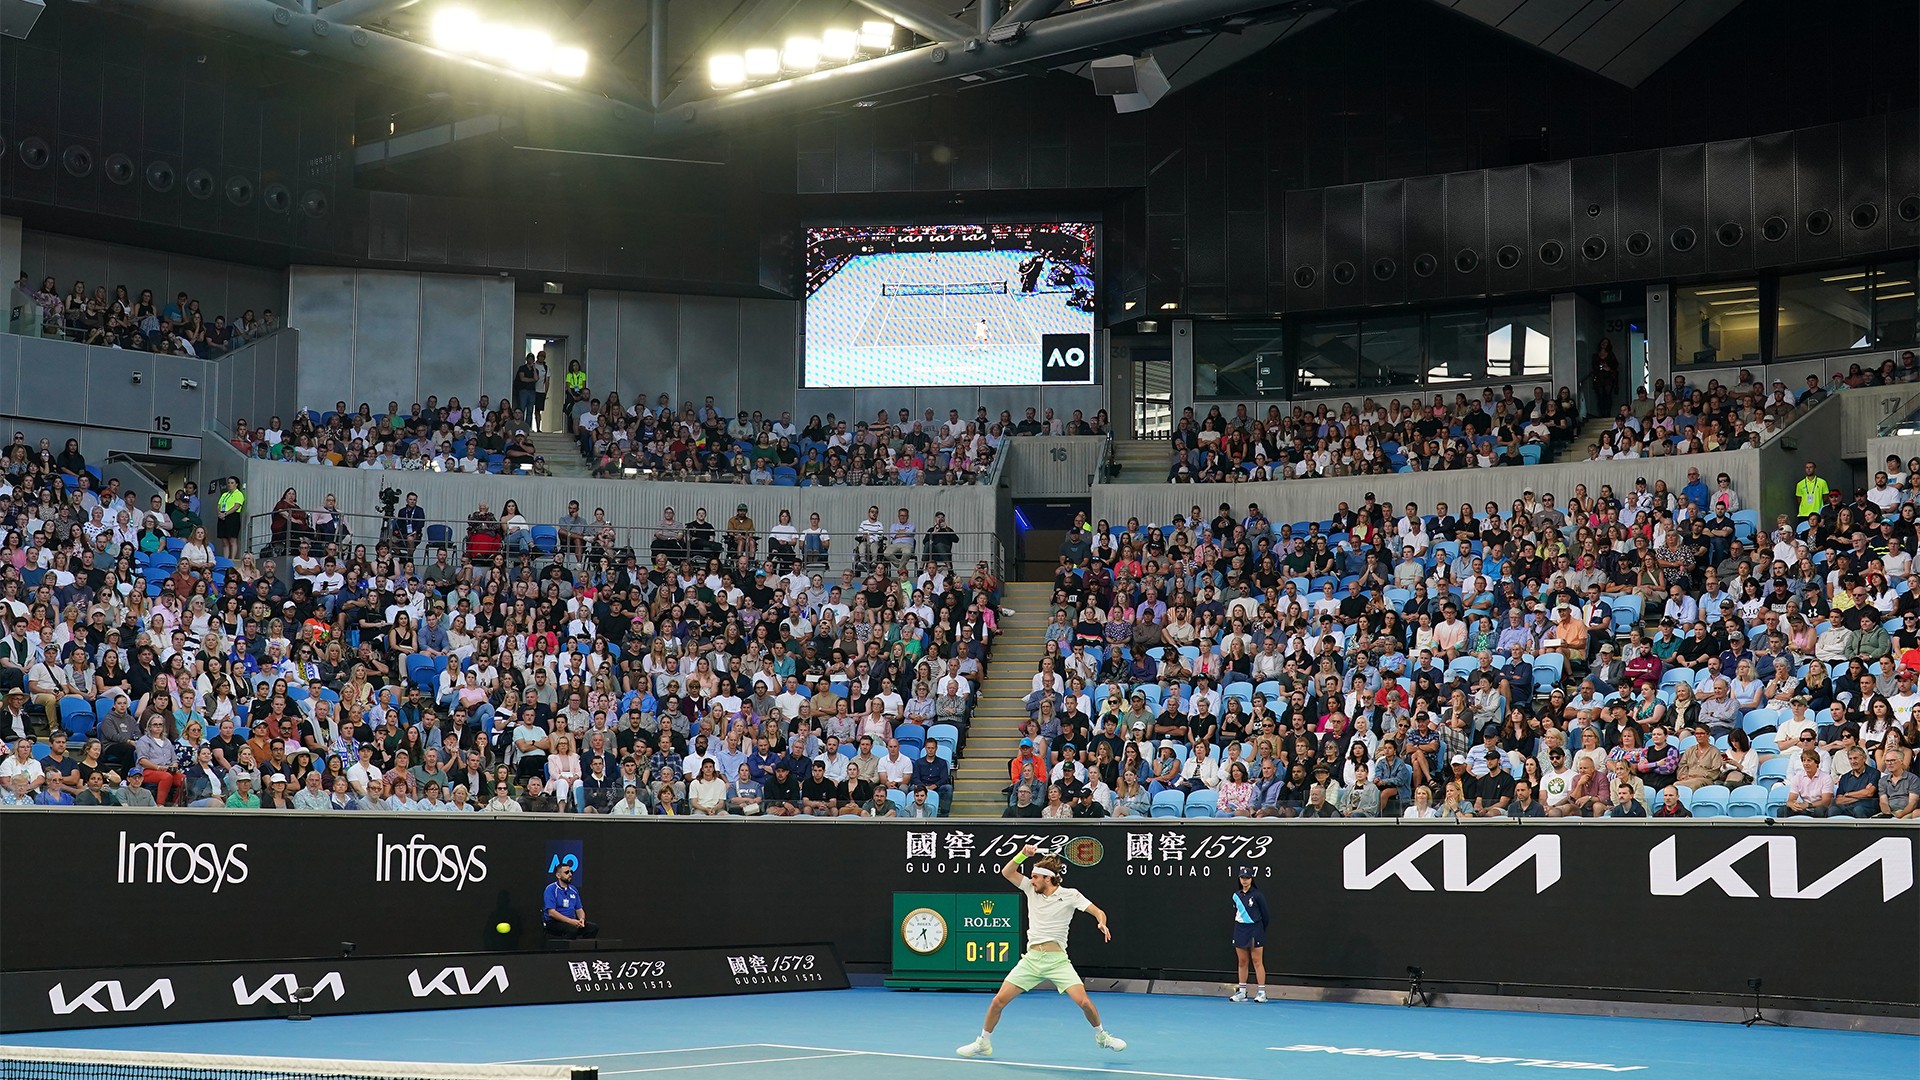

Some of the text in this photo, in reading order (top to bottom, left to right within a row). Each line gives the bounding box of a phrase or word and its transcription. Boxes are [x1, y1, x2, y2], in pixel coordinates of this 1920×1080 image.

[540, 302, 556, 316] 37
[1606, 319, 1624, 332] 39
[1046, 347, 1085, 367] AO
[1111, 346, 1128, 358] 38
[1880, 397, 1901, 414] 17
[154, 415, 171, 431] 15
[1050, 447, 1067, 461] 16
[906, 830, 976, 860] 國窖
[1126, 831, 1273, 861] 國窖 1573
[118, 830, 249, 893] Infosys
[376, 833, 487, 891] Infosys
[906, 862, 1068, 875] GUOJIAO 13
[1126, 864, 1272, 878] GUOJIAO 173
[1343, 833, 1561, 894] KIA
[1649, 834, 1914, 902] KIA
[964, 917, 1011, 928] ROLEX
[966, 941, 1010, 962] 0:17
[568, 959, 666, 982] 國窖 1573
[727, 954, 815, 976] 國窖 1573
[232, 971, 346, 1006] KIA
[408, 965, 509, 997] KIA
[575, 980, 673, 992] GUOJIAO 1573
[734, 973, 822, 985] GUOJIAO 1573
[48, 978, 176, 1015] KIA
[1266, 1044, 1649, 1072] MELBOURNE
